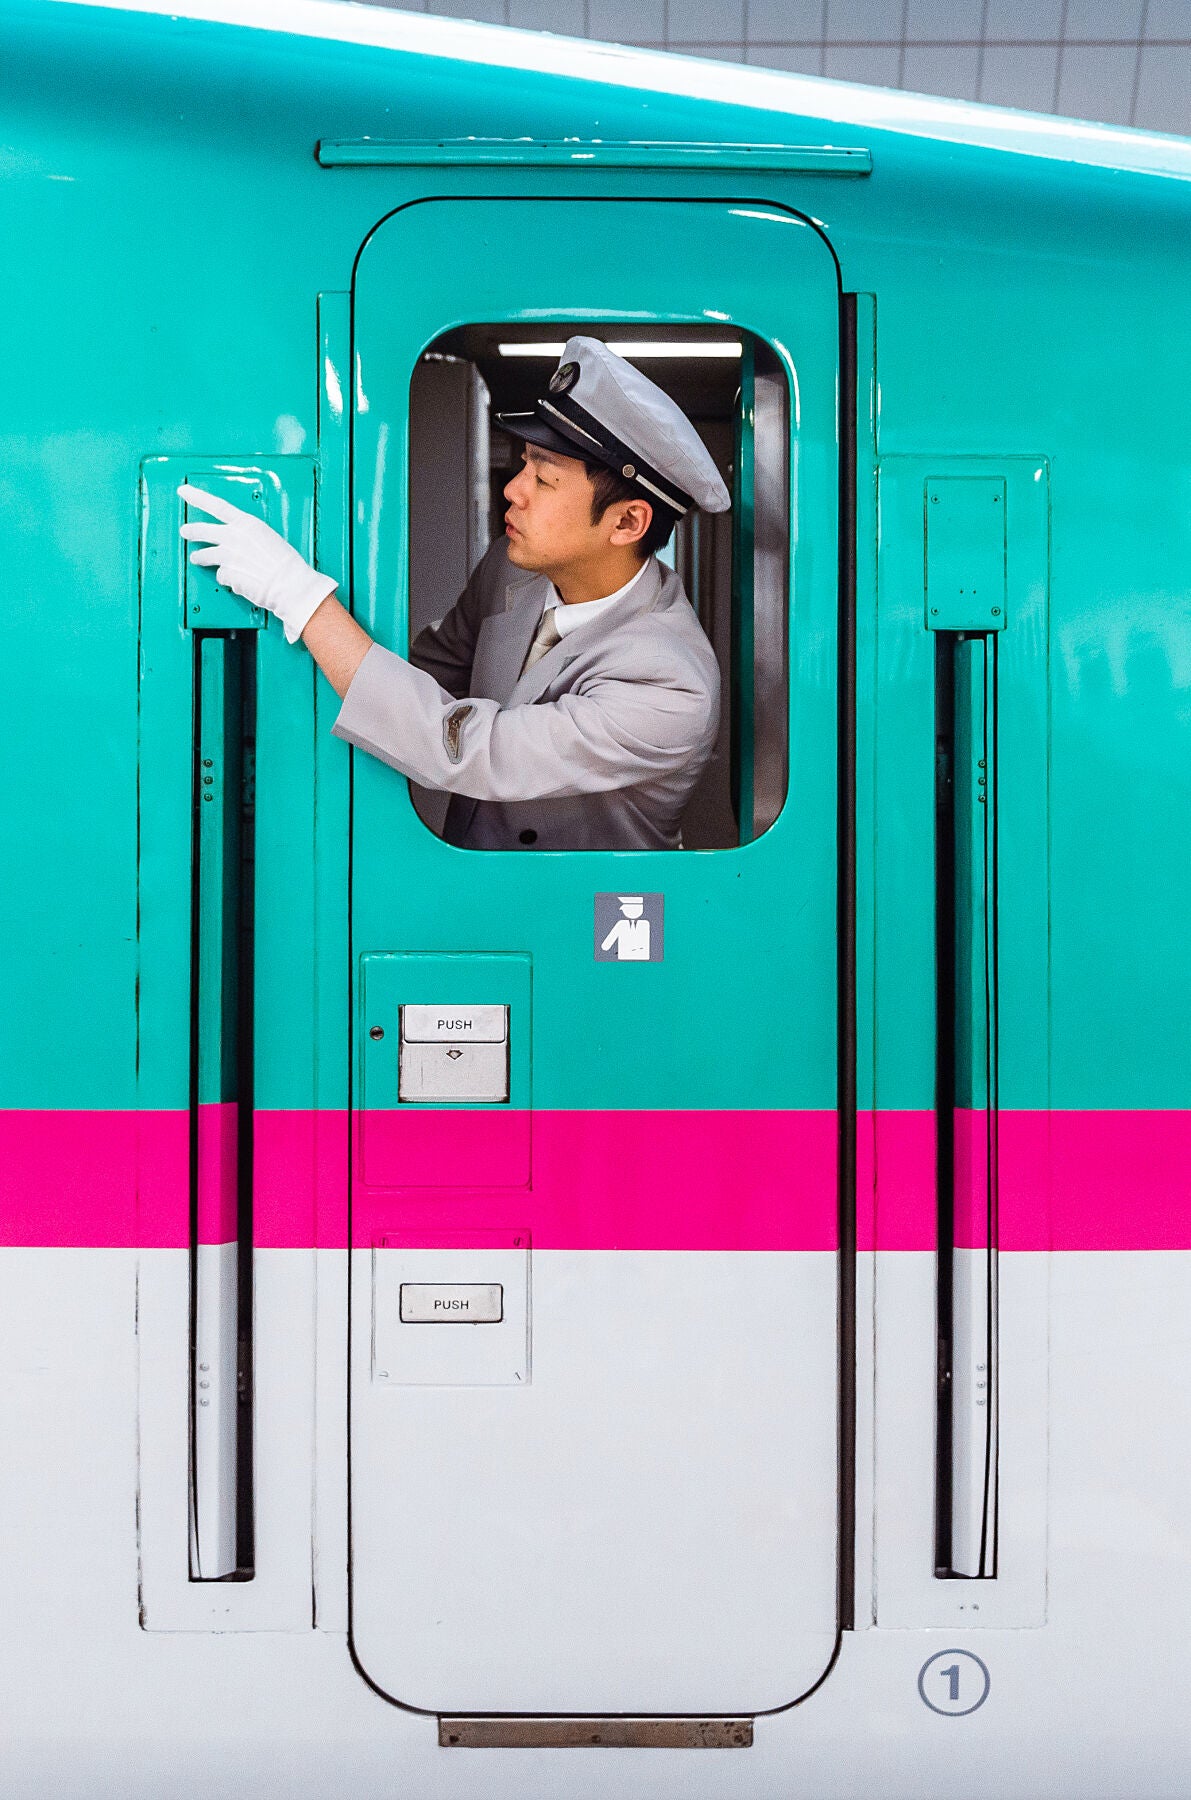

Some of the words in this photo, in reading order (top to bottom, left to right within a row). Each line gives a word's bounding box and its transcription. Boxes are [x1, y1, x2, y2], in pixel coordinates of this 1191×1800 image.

[437, 1019, 472, 1030] PUSH
[434, 1299, 469, 1310] PUSH
[939, 1664, 960, 1700] 1
